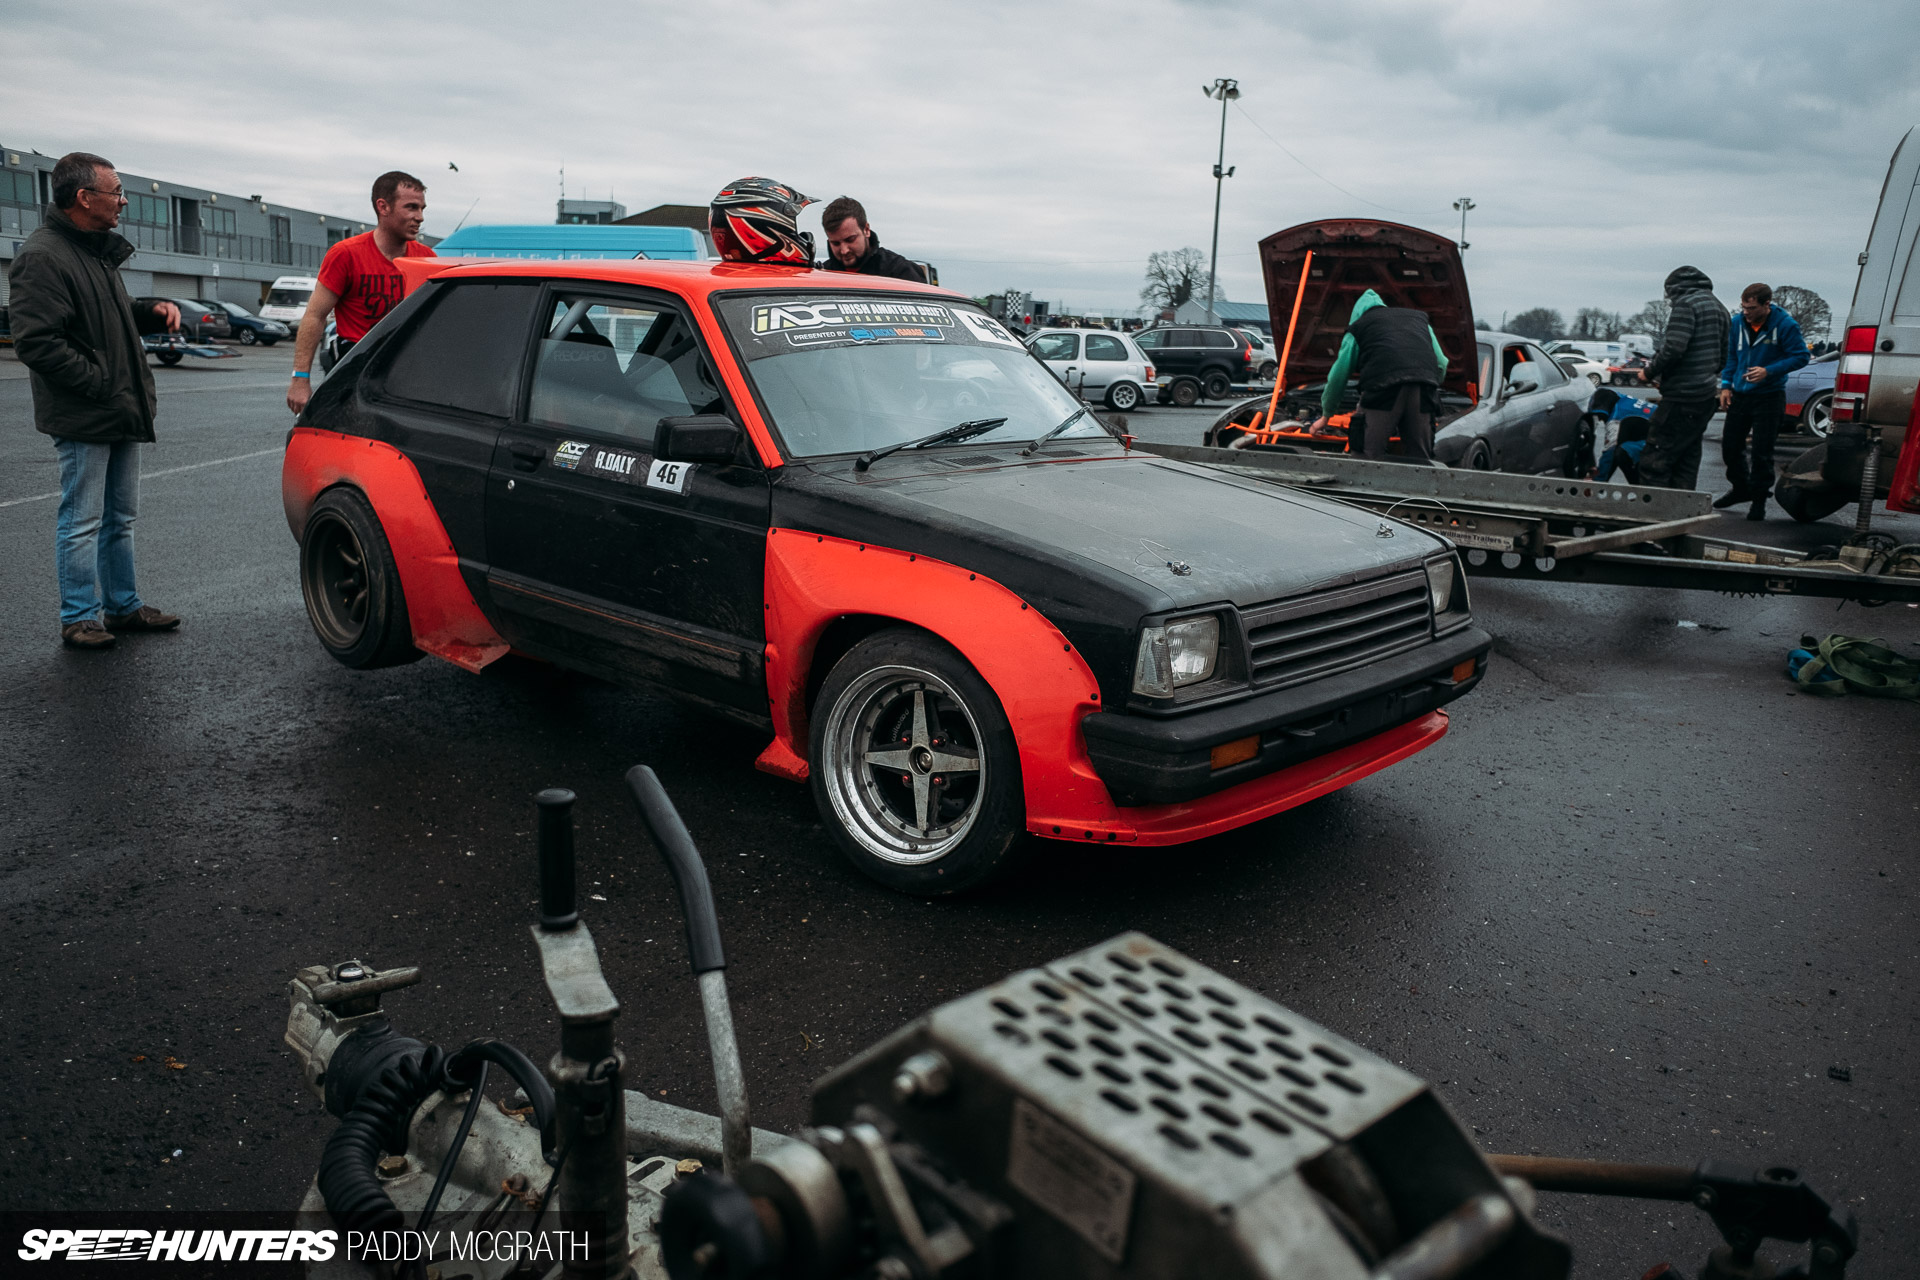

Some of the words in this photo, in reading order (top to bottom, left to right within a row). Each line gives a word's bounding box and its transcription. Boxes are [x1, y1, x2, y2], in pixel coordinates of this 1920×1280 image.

[838, 303, 871, 315] IRISH
[869, 303, 919, 316] AMATEUR
[916, 305, 947, 318] DRIFT
[844, 315, 950, 325] CHAMPIONSHIP
[793, 331, 836, 341] PRESENTED
[836, 330, 847, 338] BY
[966, 314, 1012, 342] 46
[594, 450, 636, 475] R.DALY
[656, 463, 680, 485] 46
[1440, 530, 1472, 540] Williams
[1473, 534, 1502, 544] Trailers
[891, 706, 910, 742] wilwood
